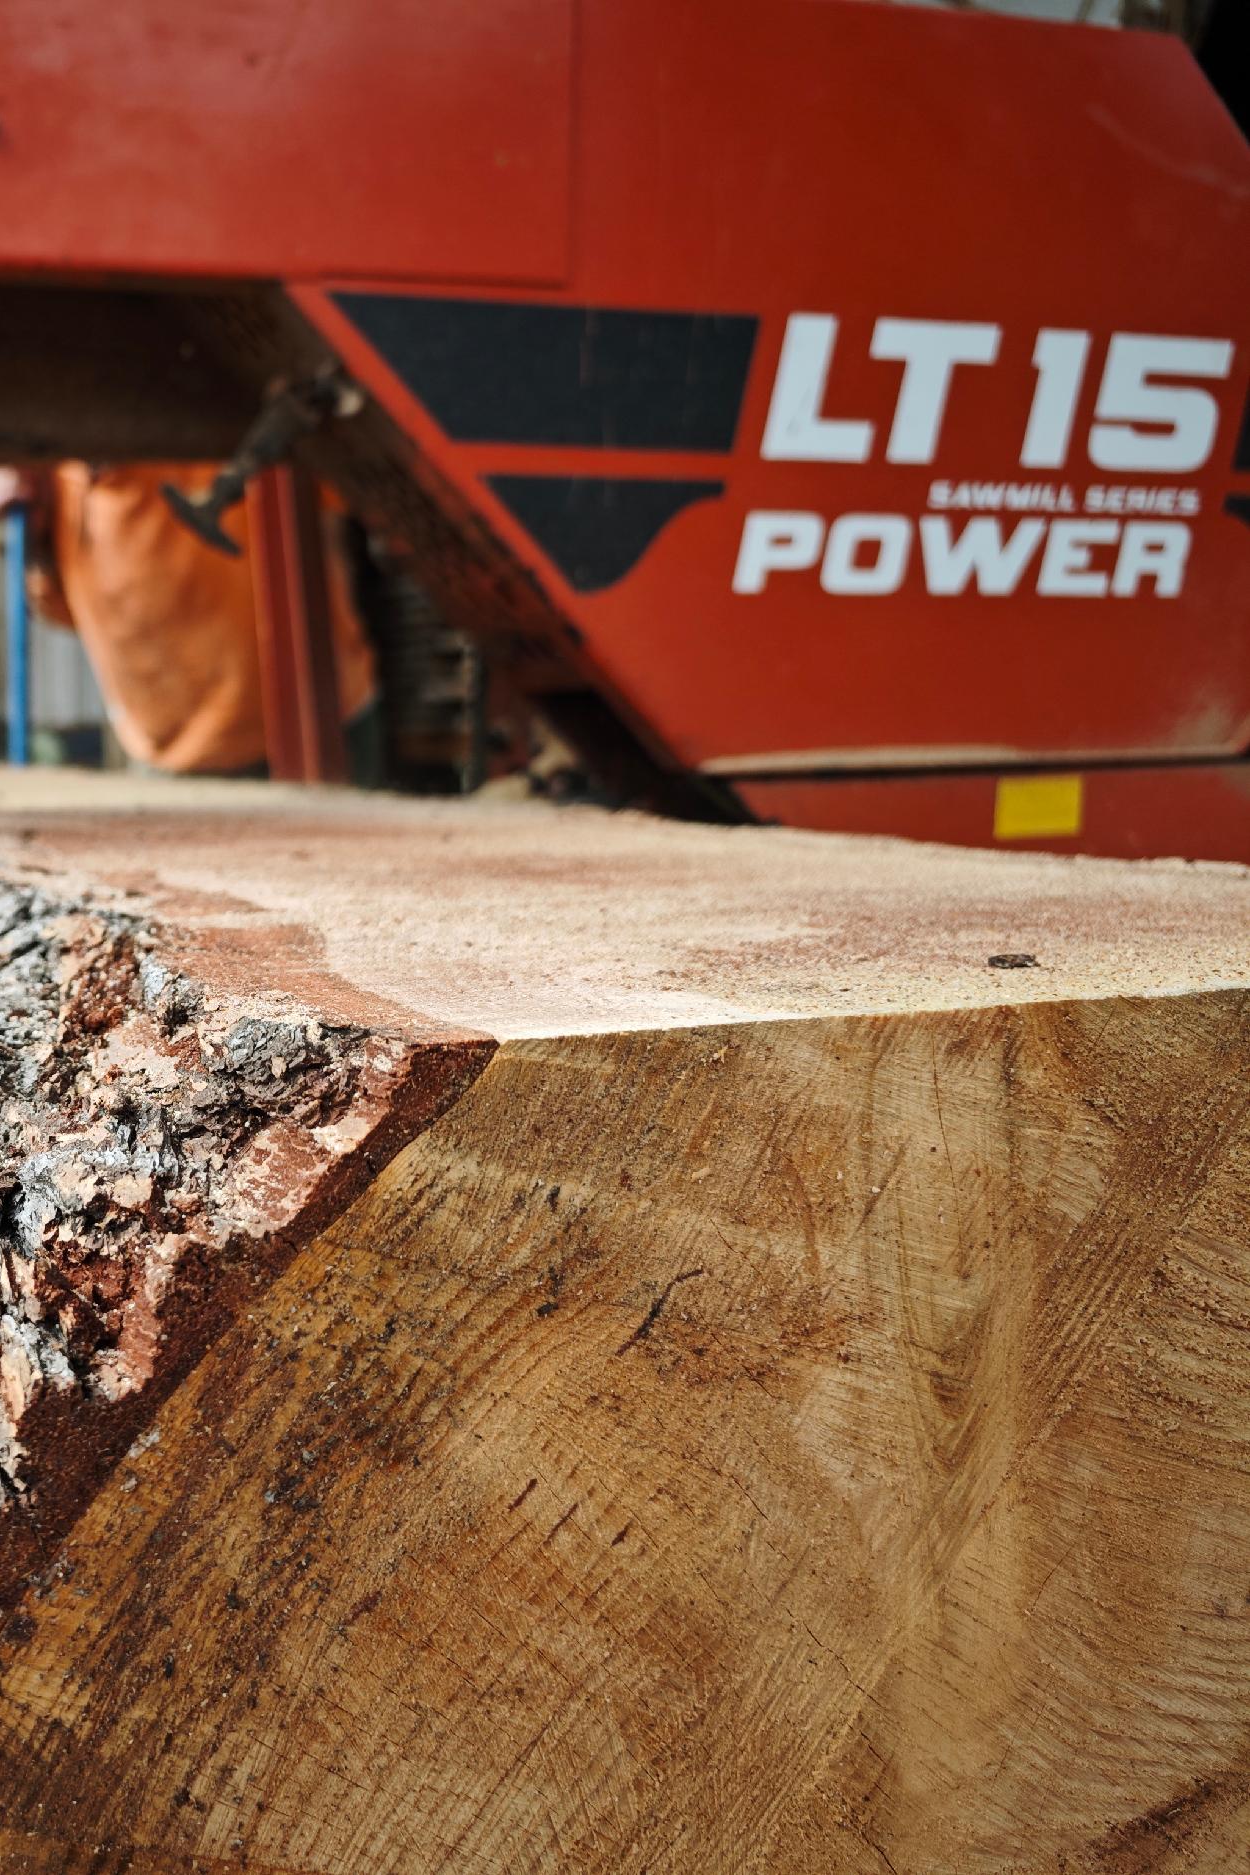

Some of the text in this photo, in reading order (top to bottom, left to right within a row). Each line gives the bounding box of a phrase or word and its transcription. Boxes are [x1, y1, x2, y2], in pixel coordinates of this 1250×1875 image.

[760, 311, 1235, 473] LT 15
[927, 479, 1201, 516] SAWMILL SERIES
[732, 510, 1192, 598] POWER
